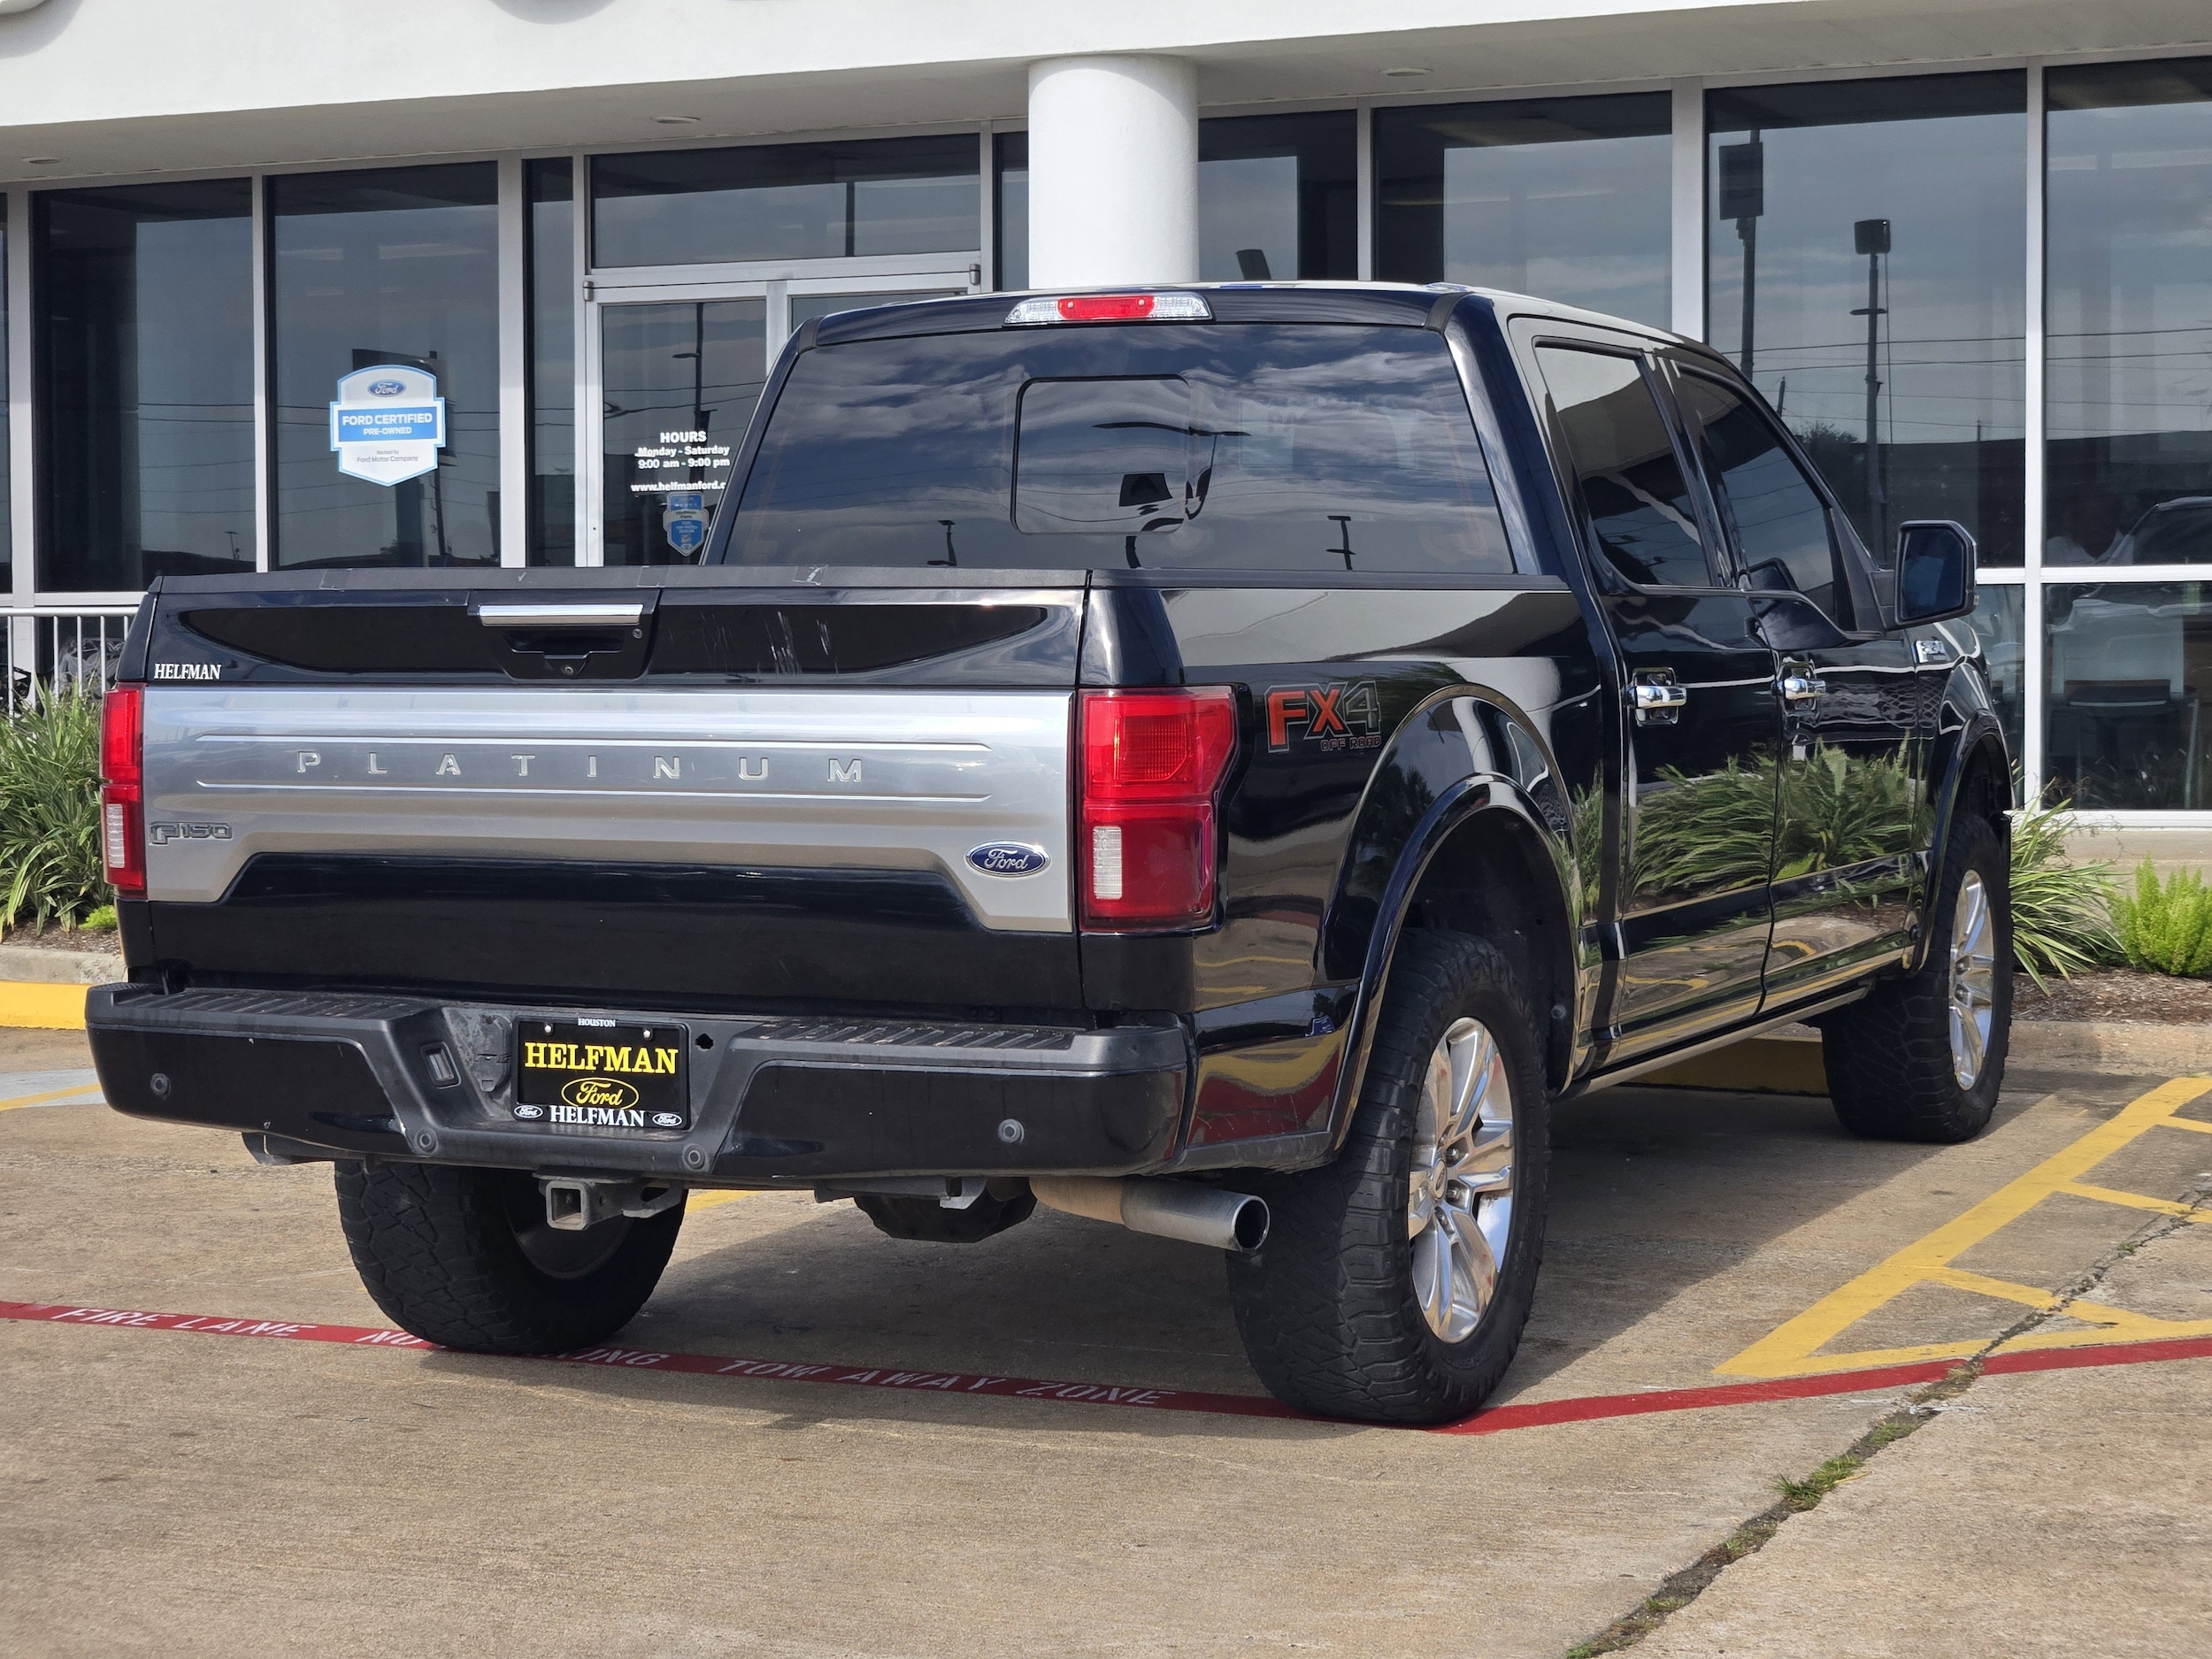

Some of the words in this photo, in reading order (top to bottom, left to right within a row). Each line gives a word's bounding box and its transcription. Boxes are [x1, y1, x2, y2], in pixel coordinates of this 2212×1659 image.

[375, 382, 399, 395] Ford
[342, 416, 373, 426] FORD
[374, 413, 433, 425] CERTIFIED
[363, 426, 412, 435] PRE-OWNED
[660, 431, 707, 443] HOURS
[637, 447, 677, 457] Monday
[684, 445, 730, 457] Saturday
[390, 455, 419, 464] Company
[638, 459, 660, 469] 9:00
[687, 457, 711, 467] 9:00
[713, 458, 731, 468] pm
[154, 664, 221, 680] HELFMAN
[1264, 680, 1382, 753] FX4
[1320, 738, 1347, 752] OFF
[1349, 735, 1382, 750] ROAD
[296, 749, 863, 783] PLATINUM
[984, 849, 1030, 870] Ford
[577, 1018, 617, 1027] HOUSTON
[524, 1041, 680, 1074] HELFMAN
[575, 1080, 624, 1106] Ford
[549, 1105, 646, 1127] HELFMAN
[50, 1308, 177, 1326] FIRE
[173, 1317, 318, 1337] LANE
[718, 1360, 833, 1379] TOW
[835, 1370, 1007, 1391] AWAY
[1015, 1380, 1177, 1405] ZONE
